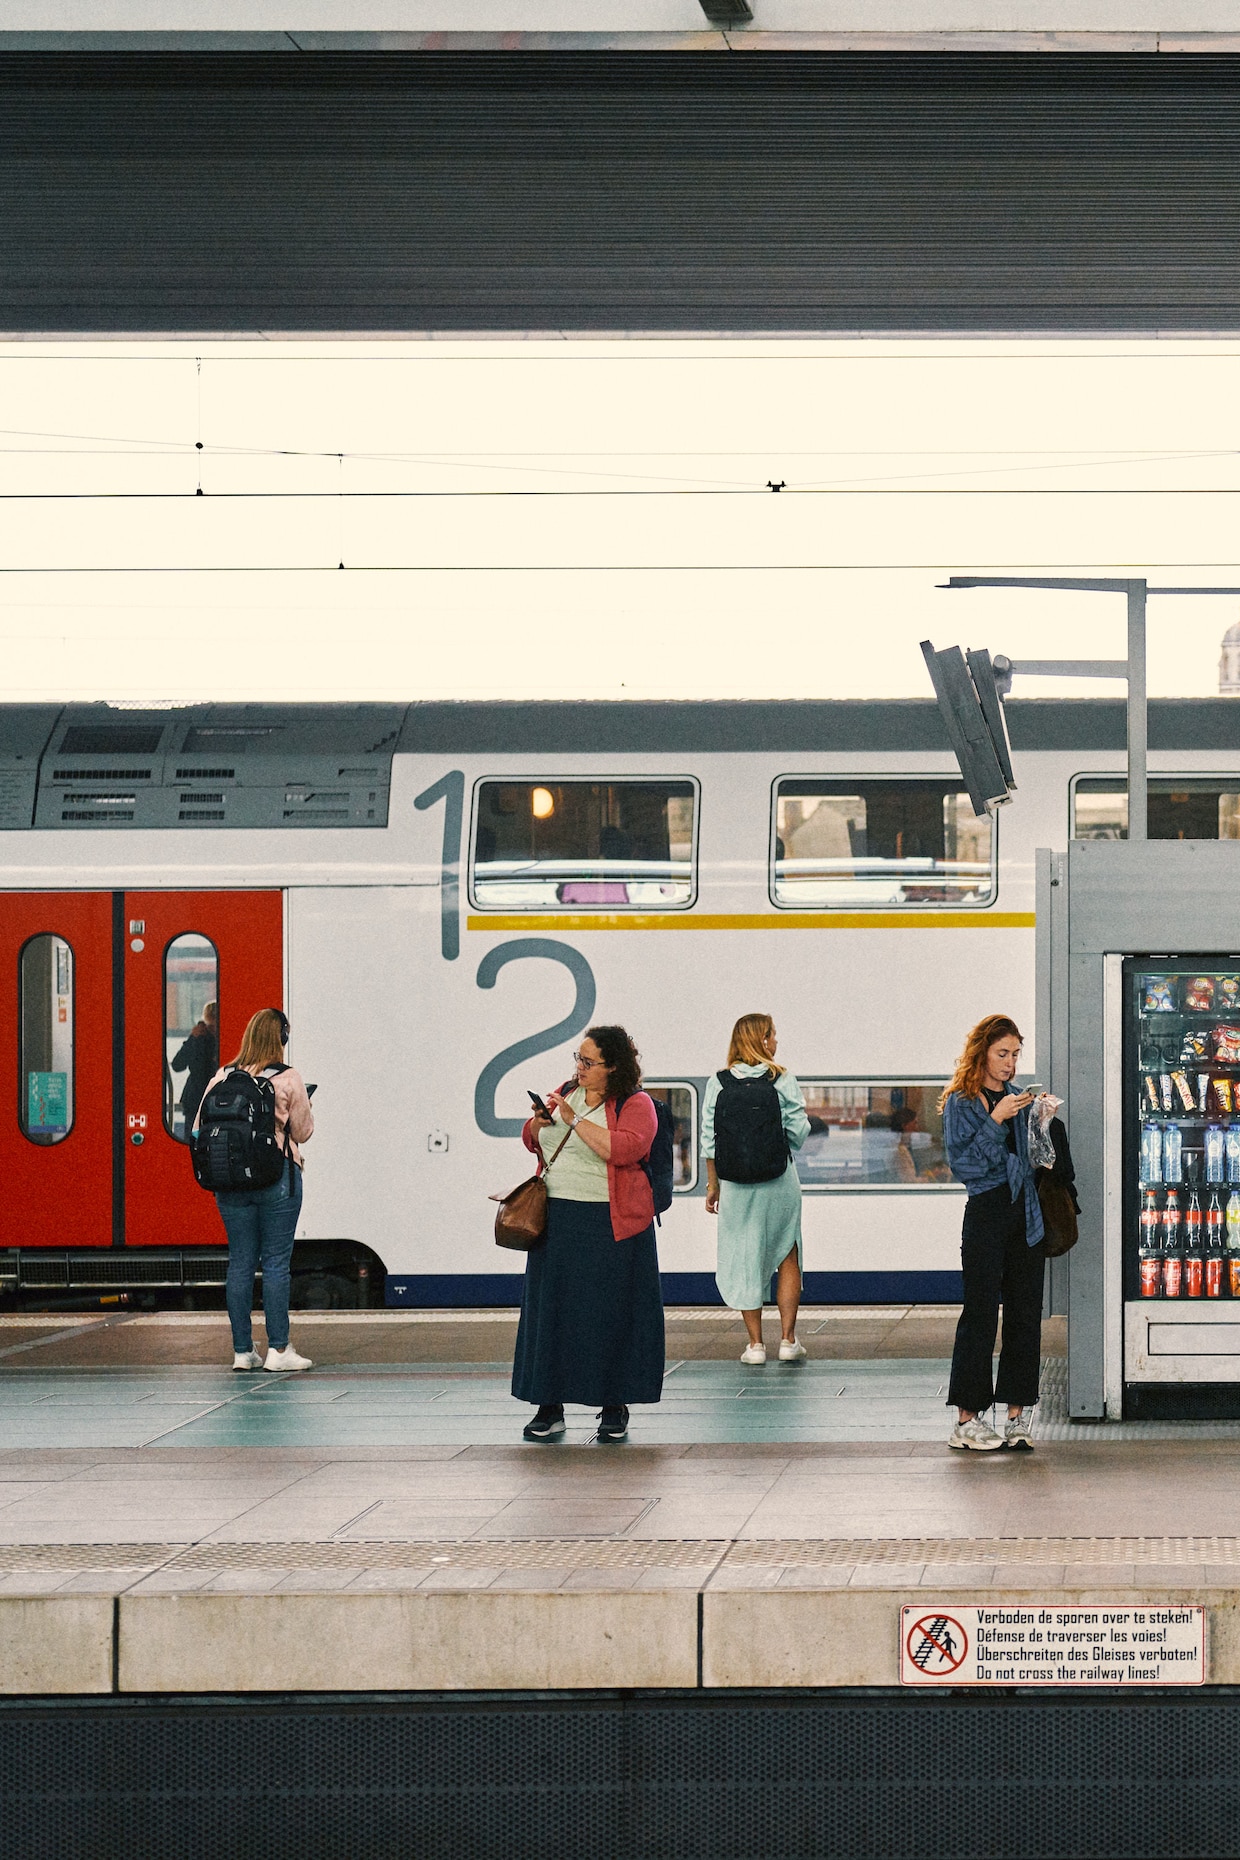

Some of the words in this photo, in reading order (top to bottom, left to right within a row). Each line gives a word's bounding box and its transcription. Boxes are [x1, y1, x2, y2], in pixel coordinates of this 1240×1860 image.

[412, 769, 466, 961] 1
[474, 938, 596, 1138] 2
[977, 1609, 1034, 1624] Verboden
[1038, 1609, 1052, 1624] de
[1056, 1614, 1098, 1627] sporen
[1102, 1614, 1130, 1624] over
[1133, 1611, 1146, 1624] te
[1149, 1609, 1193, 1624] steken!
[977, 1627, 1025, 1643] Défense
[1028, 1627, 1043, 1643] de
[1046, 1629, 1107, 1643] traverser
[1110, 1627, 1128, 1643] les
[1131, 1627, 1167, 1643] voies!
[976, 1644, 1064, 1661] Überschreiten
[1067, 1646, 1089, 1661] des
[1092, 1646, 1136, 1661] Gleises
[1139, 1646, 1197, 1661] verboten!
[976, 1665, 992, 1680] Do
[995, 1666, 1015, 1680] not
[1019, 1669, 1054, 1680] cross
[1057, 1665, 1076, 1680] the
[1080, 1665, 1124, 1683] railway
[1128, 1664, 1160, 1680] lines!
